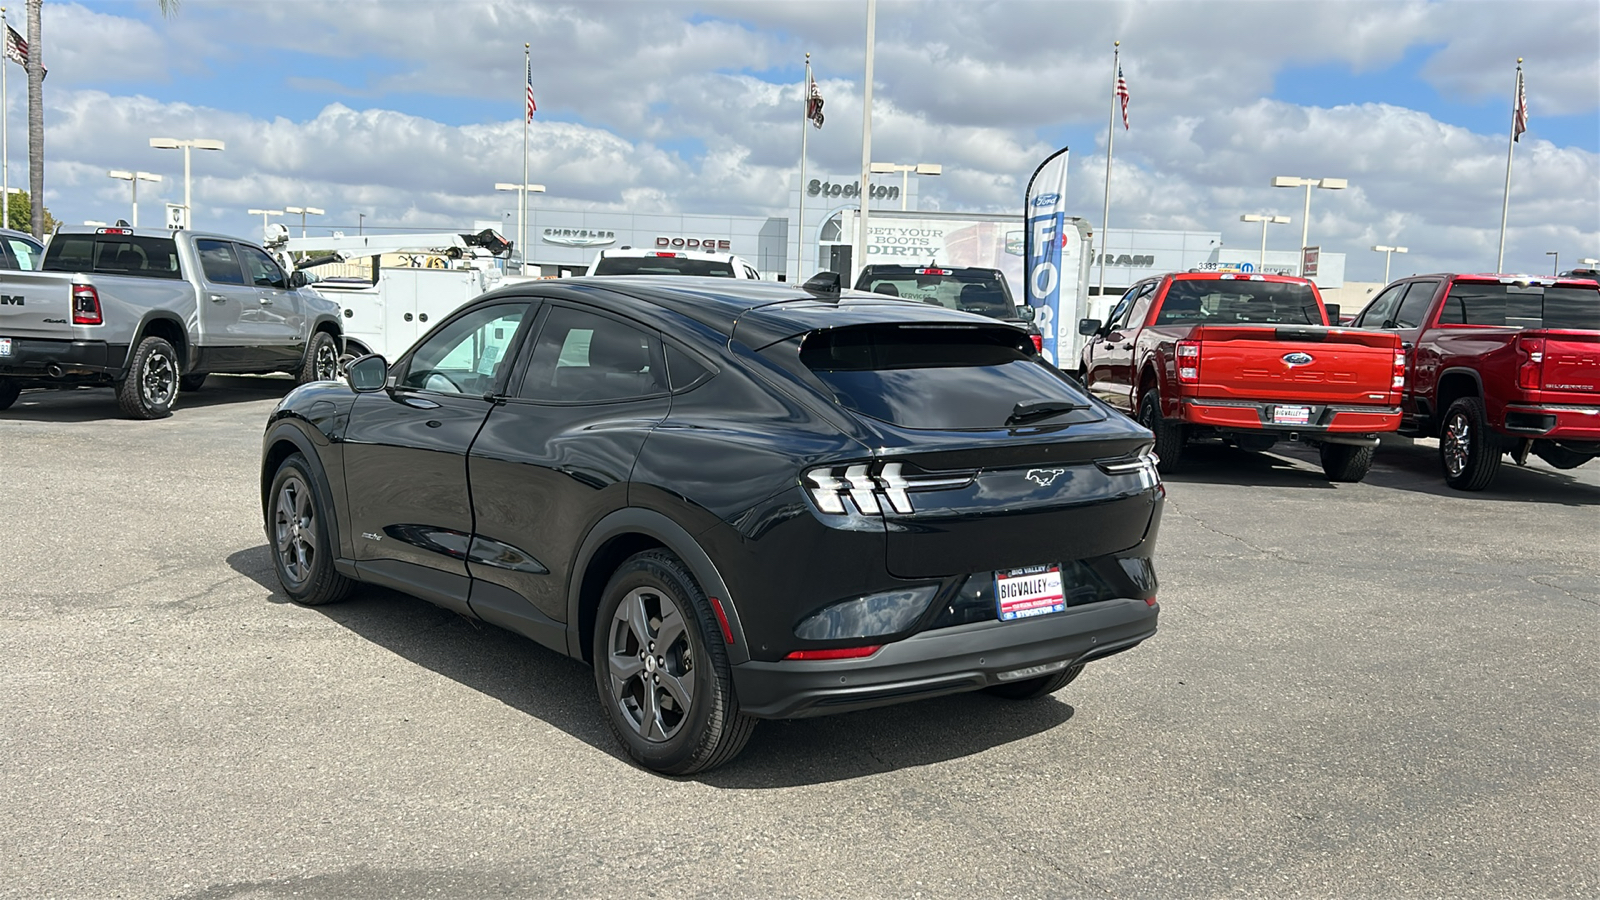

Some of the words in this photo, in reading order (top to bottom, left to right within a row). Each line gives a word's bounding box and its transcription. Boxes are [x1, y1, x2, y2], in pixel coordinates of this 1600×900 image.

[1035, 194, 1058, 206] Ford
[543, 228, 615, 238] CHRYSLER
[898, 228, 943, 237] YOUR
[656, 237, 731, 249] DODGE
[875, 236, 930, 246] BOOTS
[866, 245, 941, 257] DIRTY
[1096, 253, 1155, 267] RAM
[1011, 568, 1024, 576] BIG
[1024, 566, 1046, 574] VALLEY
[1001, 577, 1048, 599] BIGVALLEY
